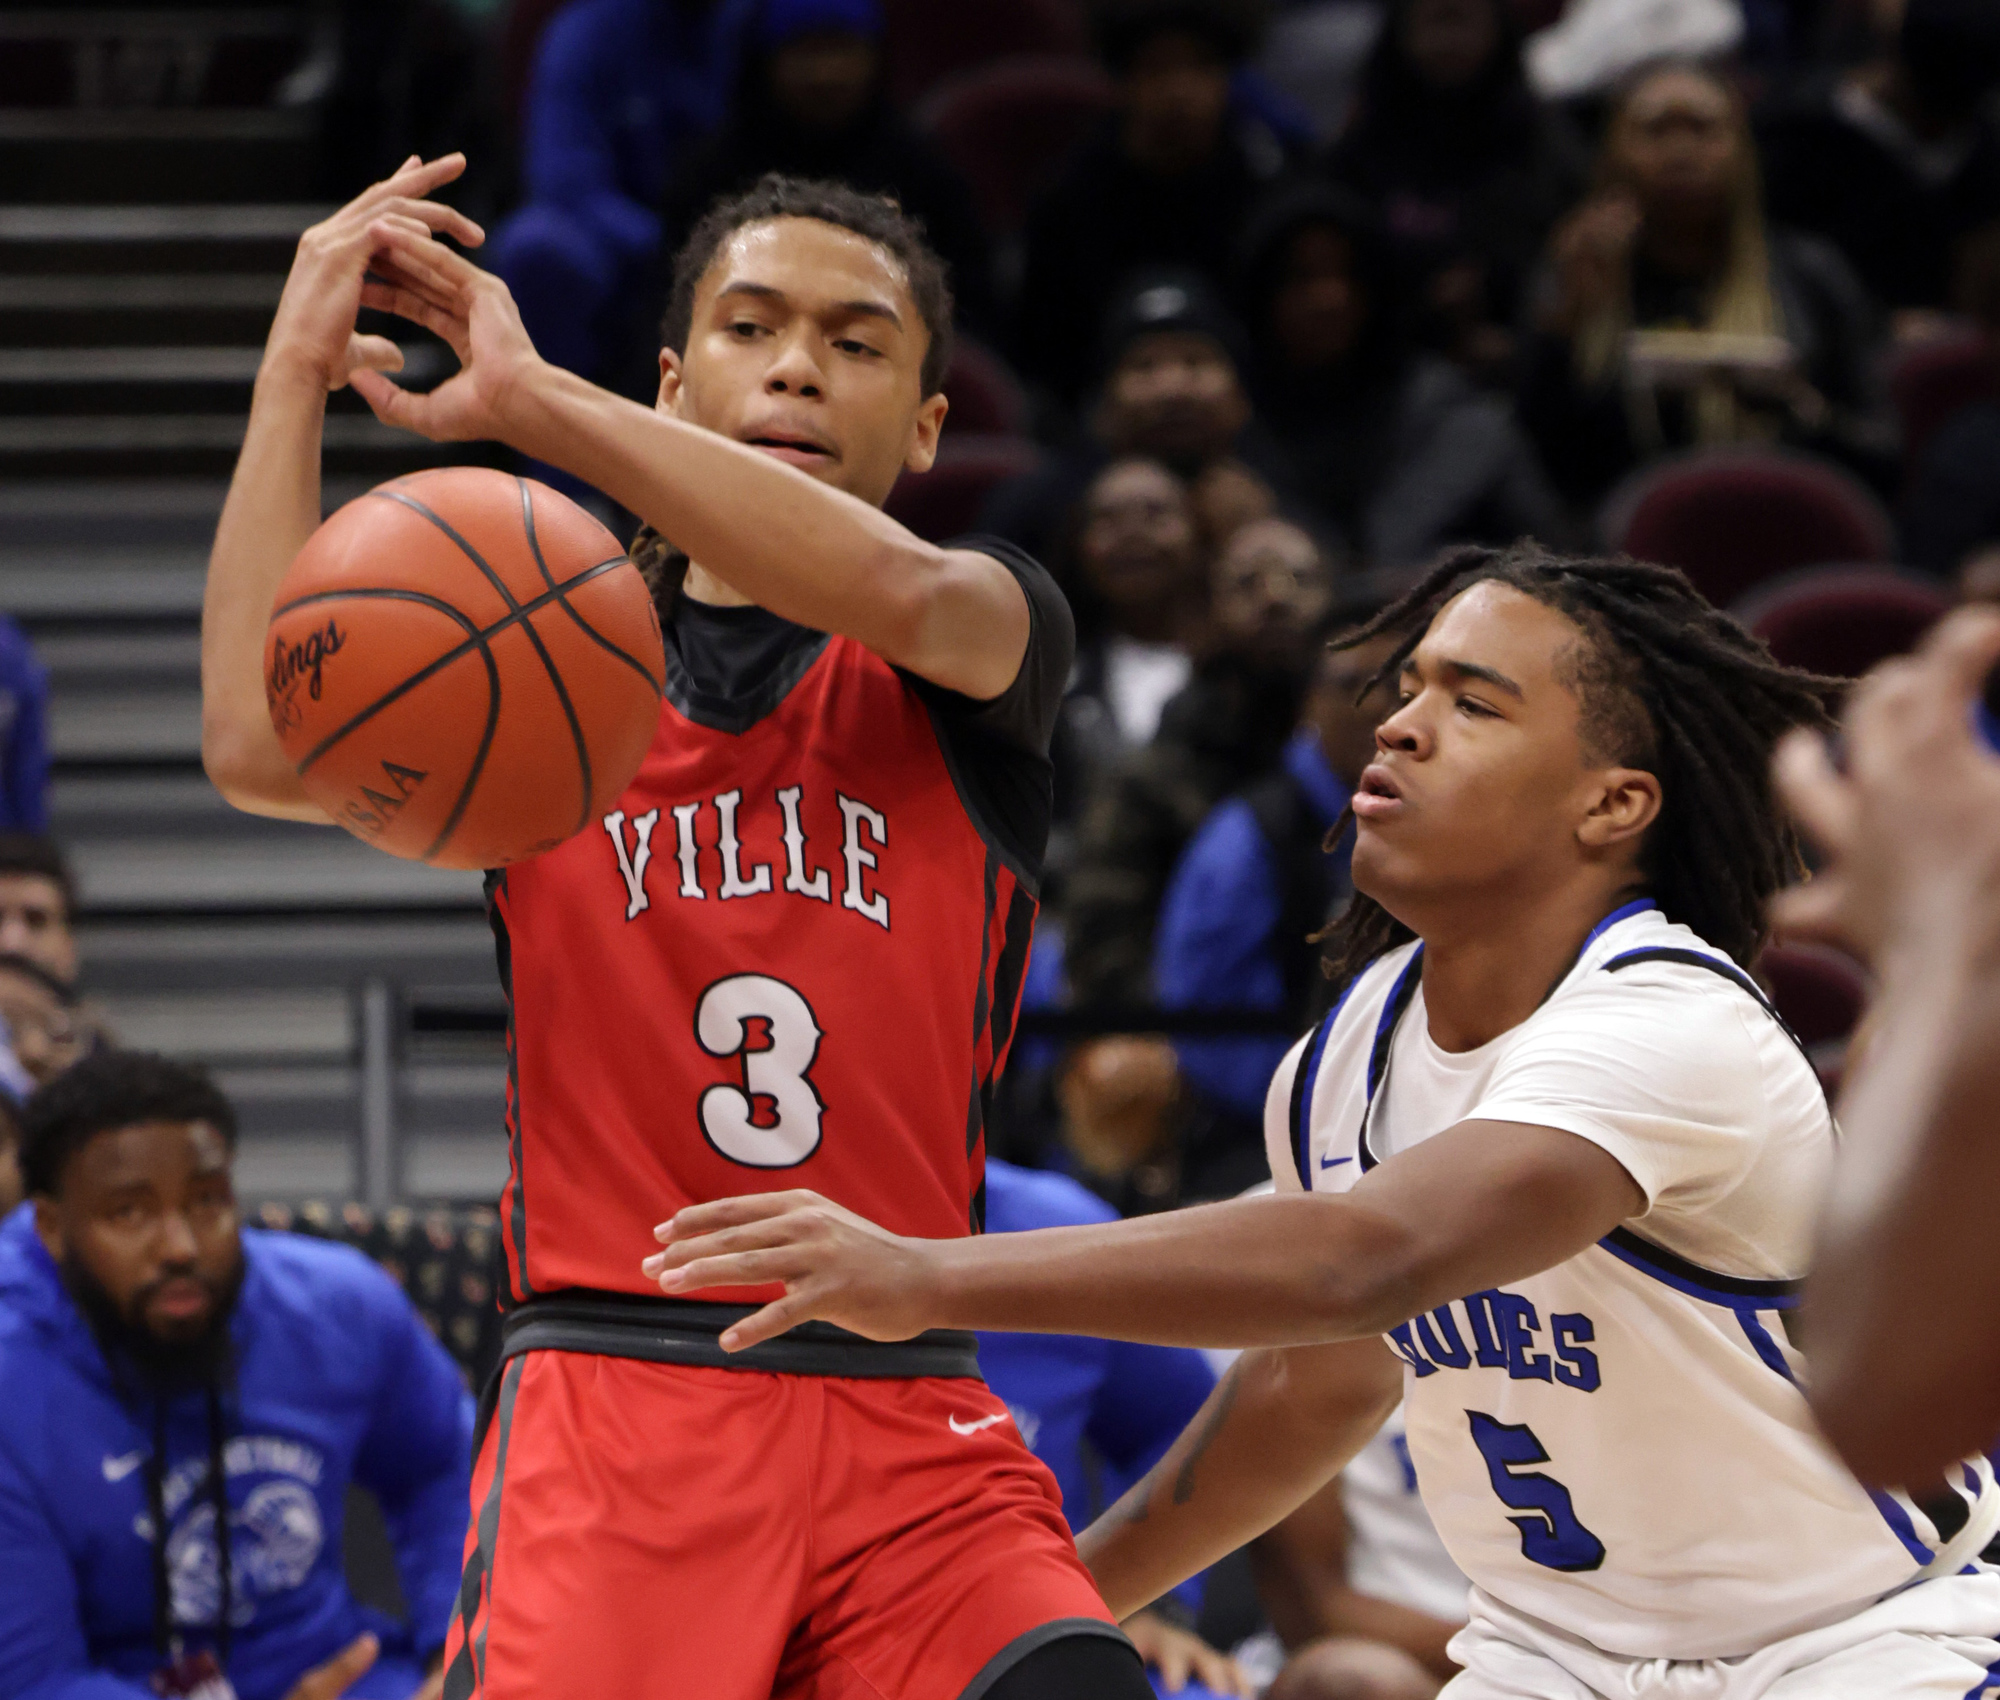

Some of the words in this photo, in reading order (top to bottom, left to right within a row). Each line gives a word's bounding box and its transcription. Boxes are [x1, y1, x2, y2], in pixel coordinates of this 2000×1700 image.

[603, 785, 891, 930] VILLE
[694, 972, 828, 1169] 3
[1463, 1409, 1606, 1572] 5
